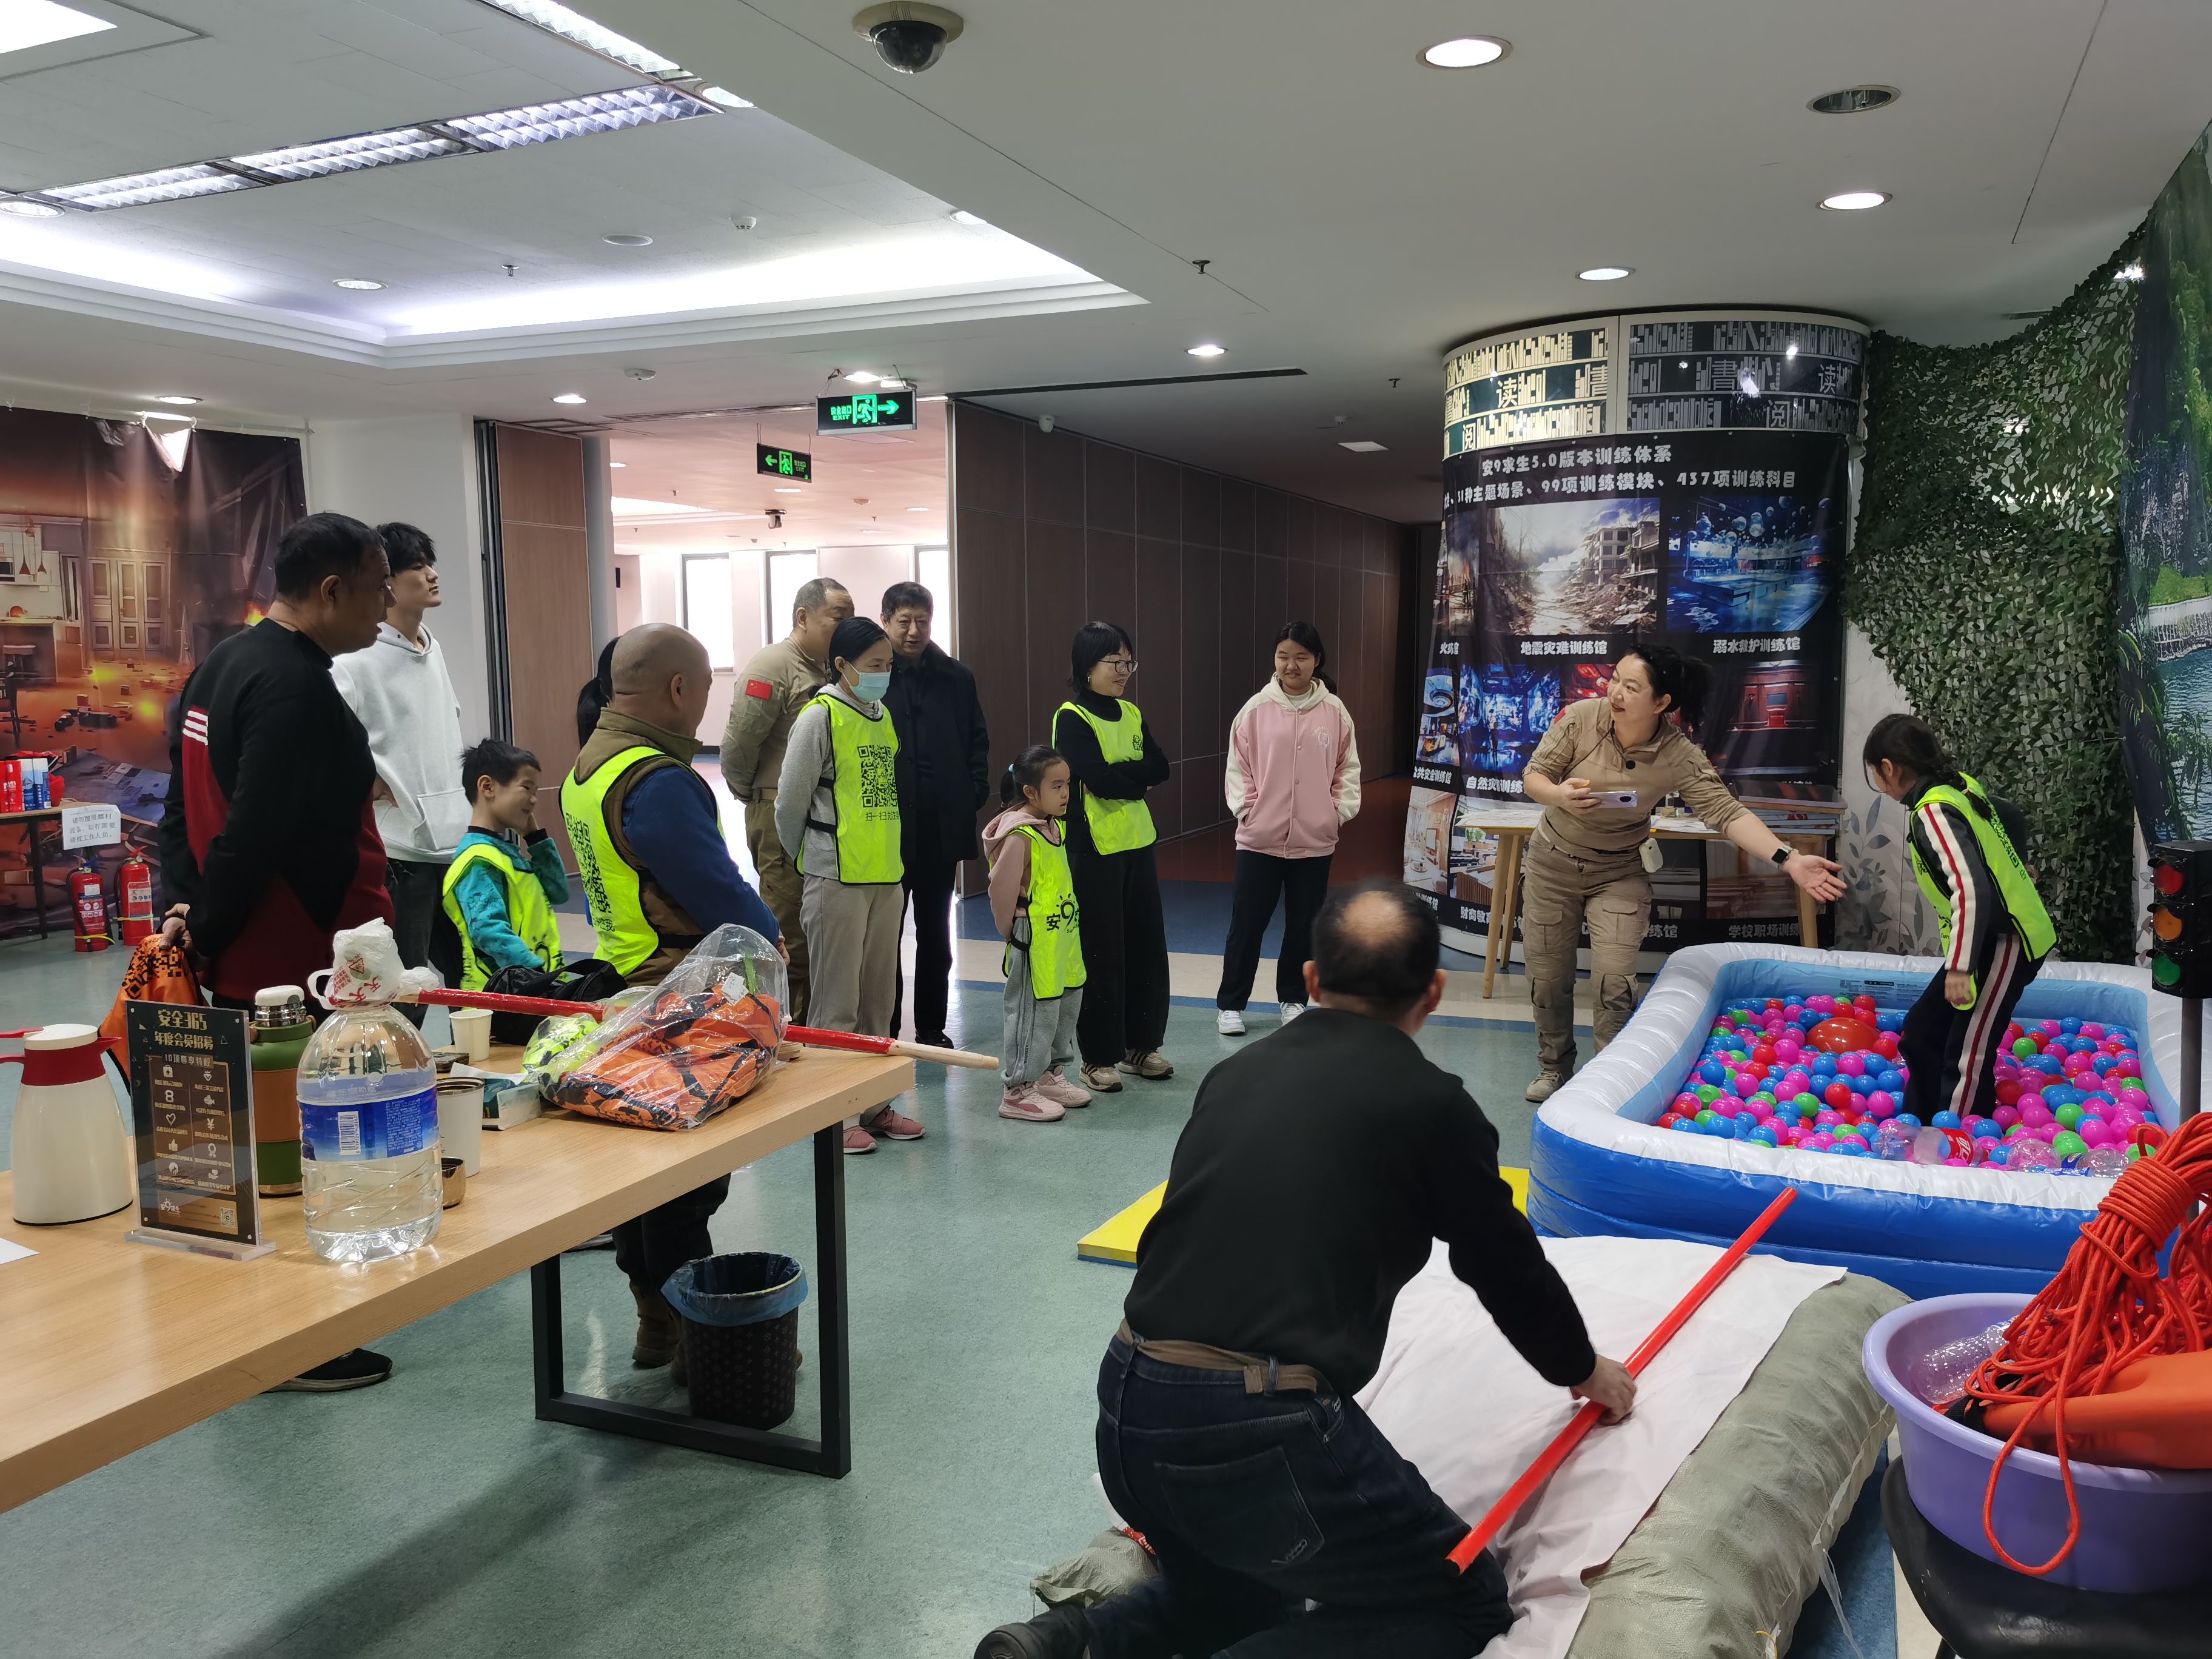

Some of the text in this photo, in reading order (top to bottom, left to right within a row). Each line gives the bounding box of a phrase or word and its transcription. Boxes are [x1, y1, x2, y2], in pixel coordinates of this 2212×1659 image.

[1496, 378, 1517, 409] 读
[1818, 364, 1836, 395] 读
[1766, 399, 1791, 428] 阅
[1463, 423, 1476, 452] 阅
[1482, 444, 1672, 477] 安9求生5.0版本训练体系
[1520, 640, 1607, 655] 地震灾难训练馆
[1713, 636, 1801, 654] 溺水救护训练馆
[158, 1009, 207, 1031] 安全365
[154, 1031, 214, 1051] 年度会员招募
